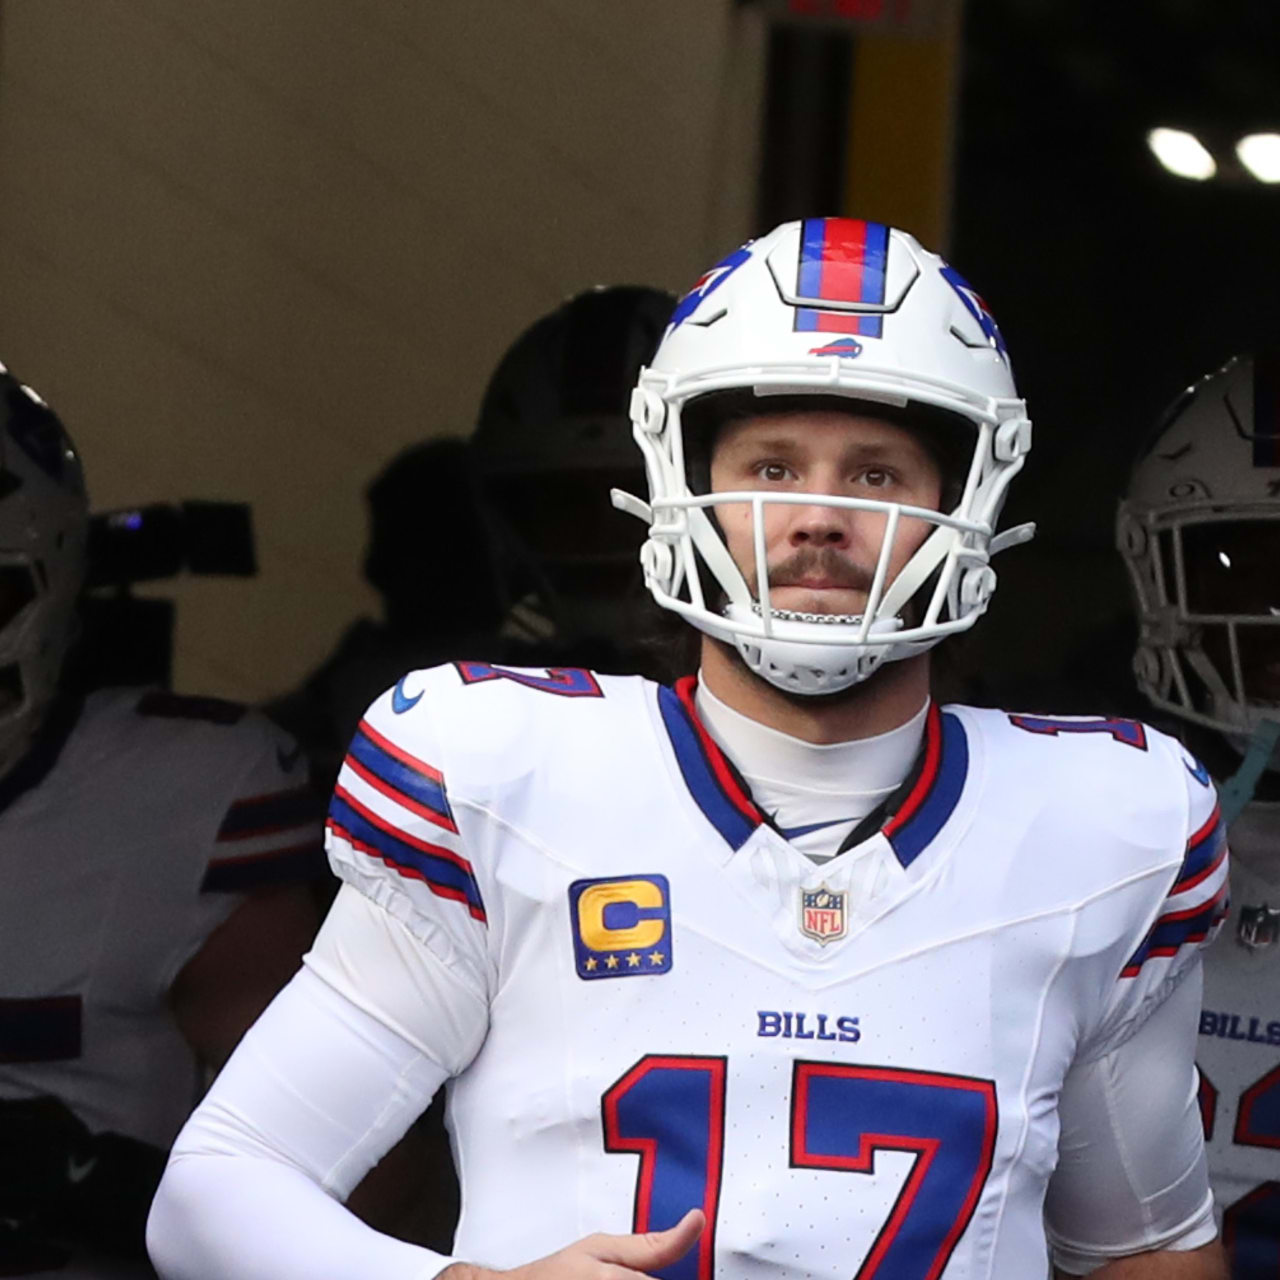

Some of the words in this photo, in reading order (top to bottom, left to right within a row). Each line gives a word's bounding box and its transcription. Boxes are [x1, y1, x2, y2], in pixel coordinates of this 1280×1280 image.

[577, 880, 666, 952] C
[805, 908, 840, 935] NFL
[756, 1010, 862, 1043] BILLS
